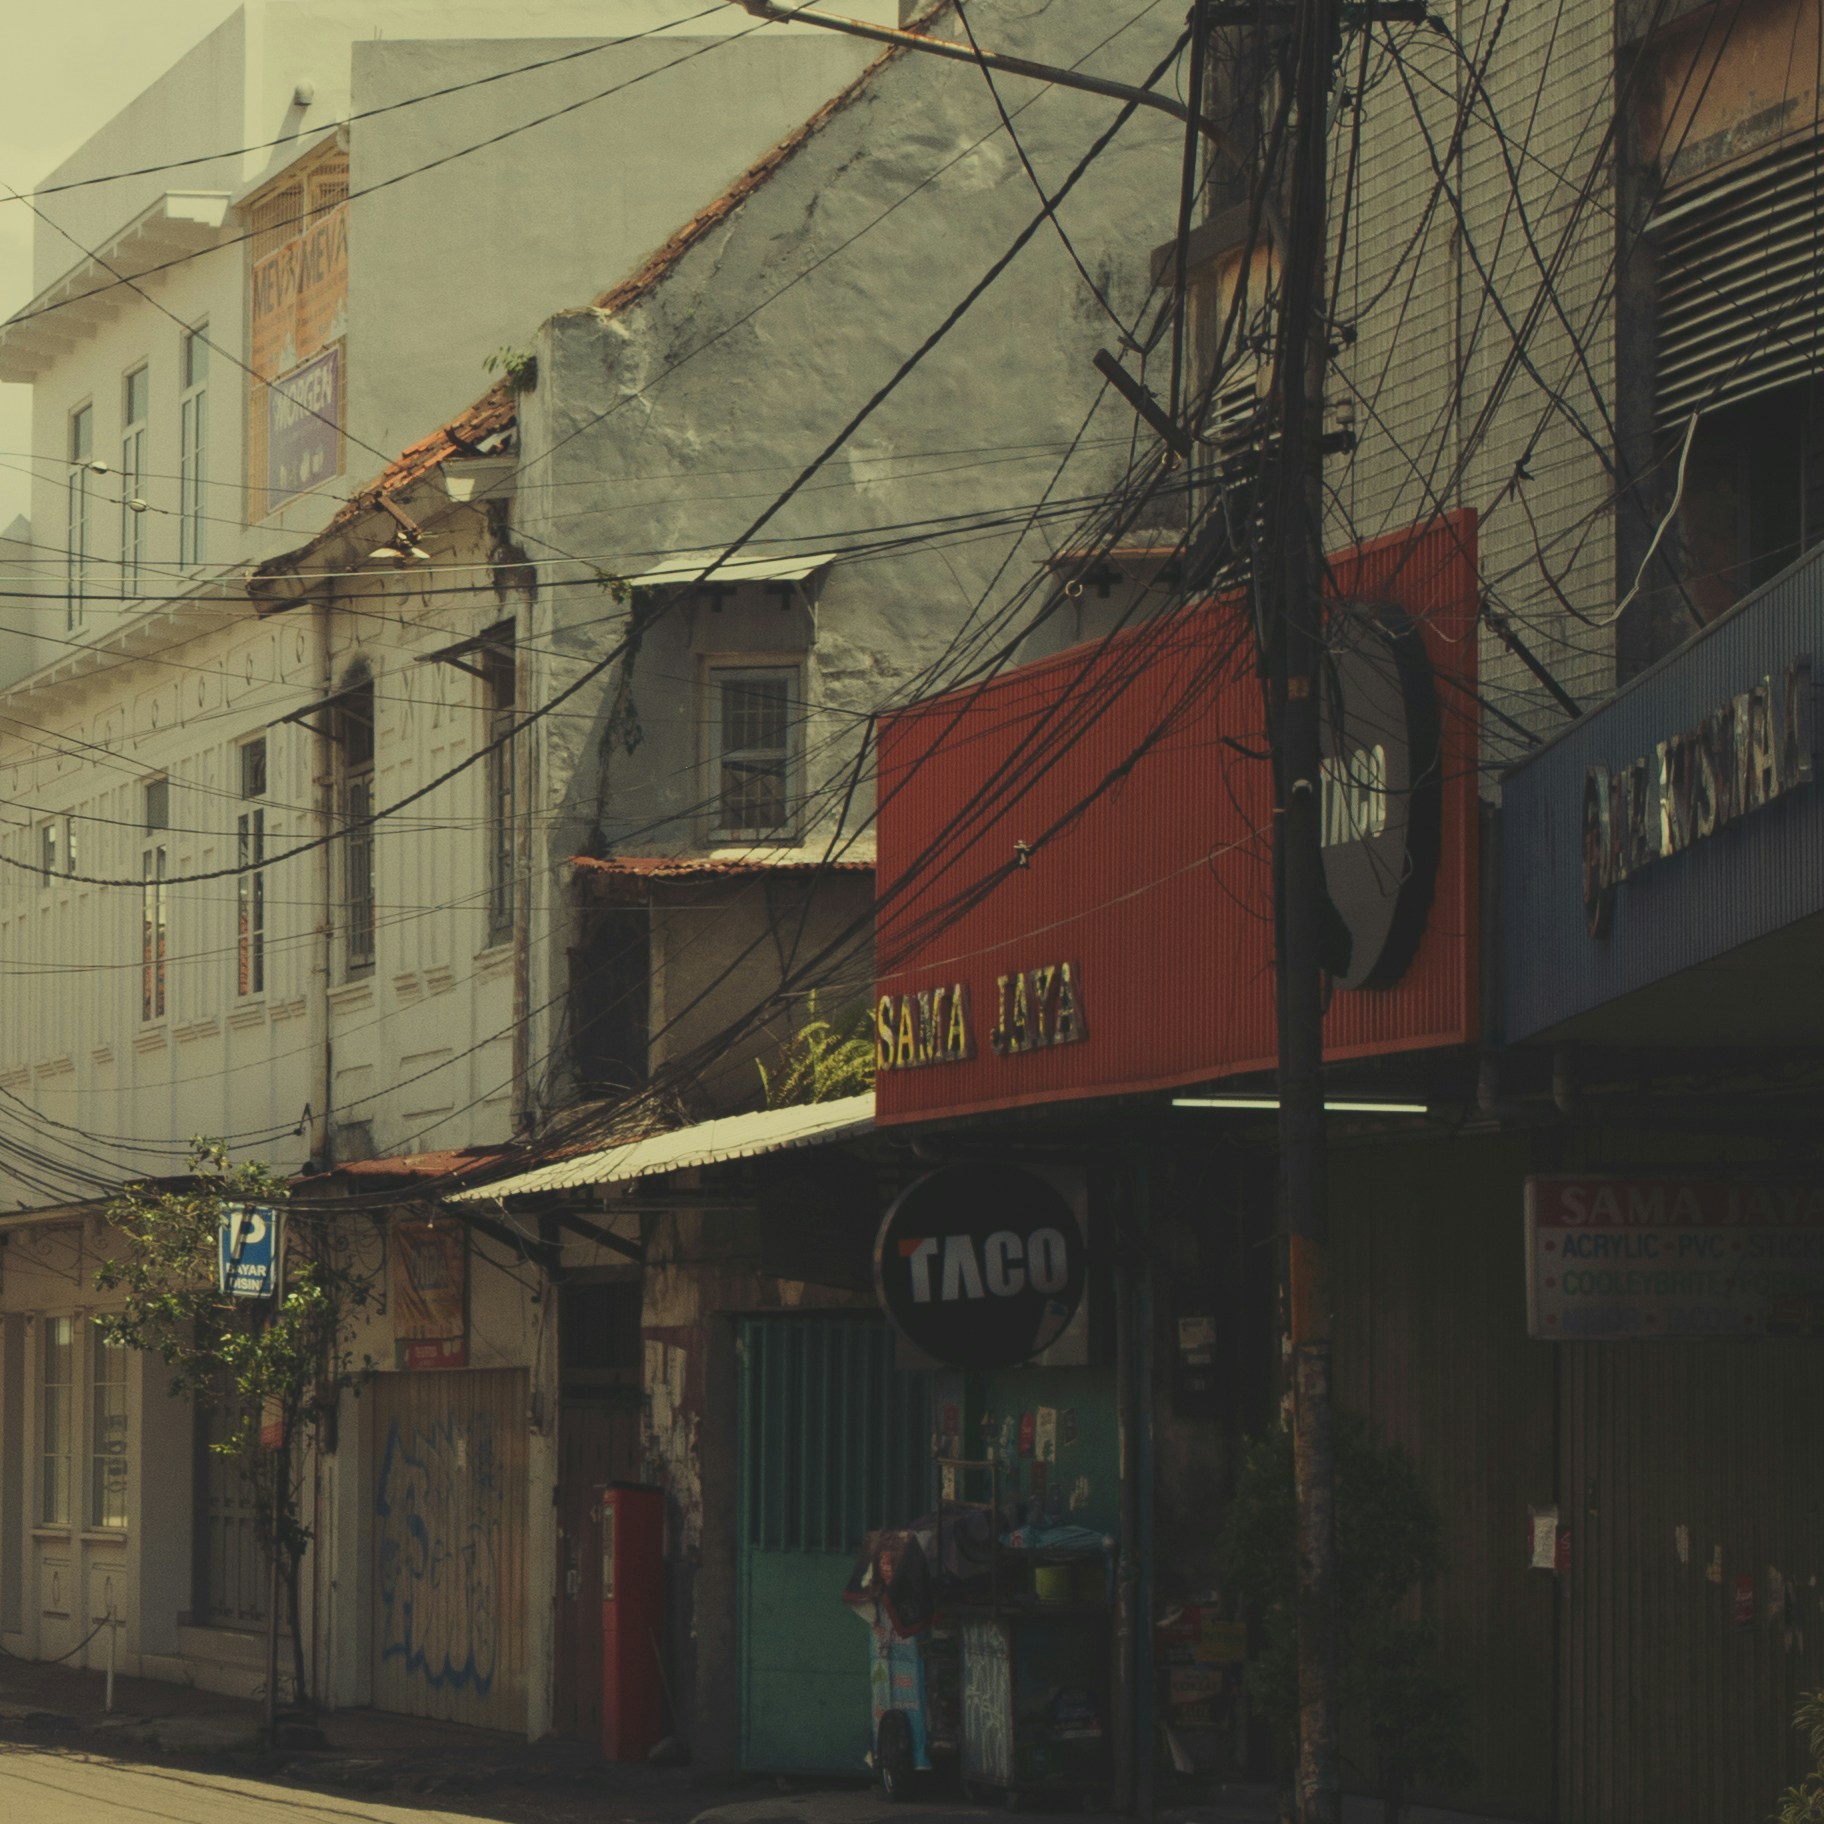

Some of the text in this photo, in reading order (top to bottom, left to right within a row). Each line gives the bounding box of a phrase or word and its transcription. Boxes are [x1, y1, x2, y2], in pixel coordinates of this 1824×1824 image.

[274, 362, 333, 431] MORGEN
[1320, 744, 1386, 848] TACO
[877, 962, 1080, 1071] SAMA JAYA
[230, 1212, 266, 1259] P
[1559, 1186, 1704, 1225] SAMA
[898, 1226, 1069, 1304] TACO
[1563, 1234, 1659, 1258] ACRYLIC
[1679, 1234, 1725, 1258] PVC
